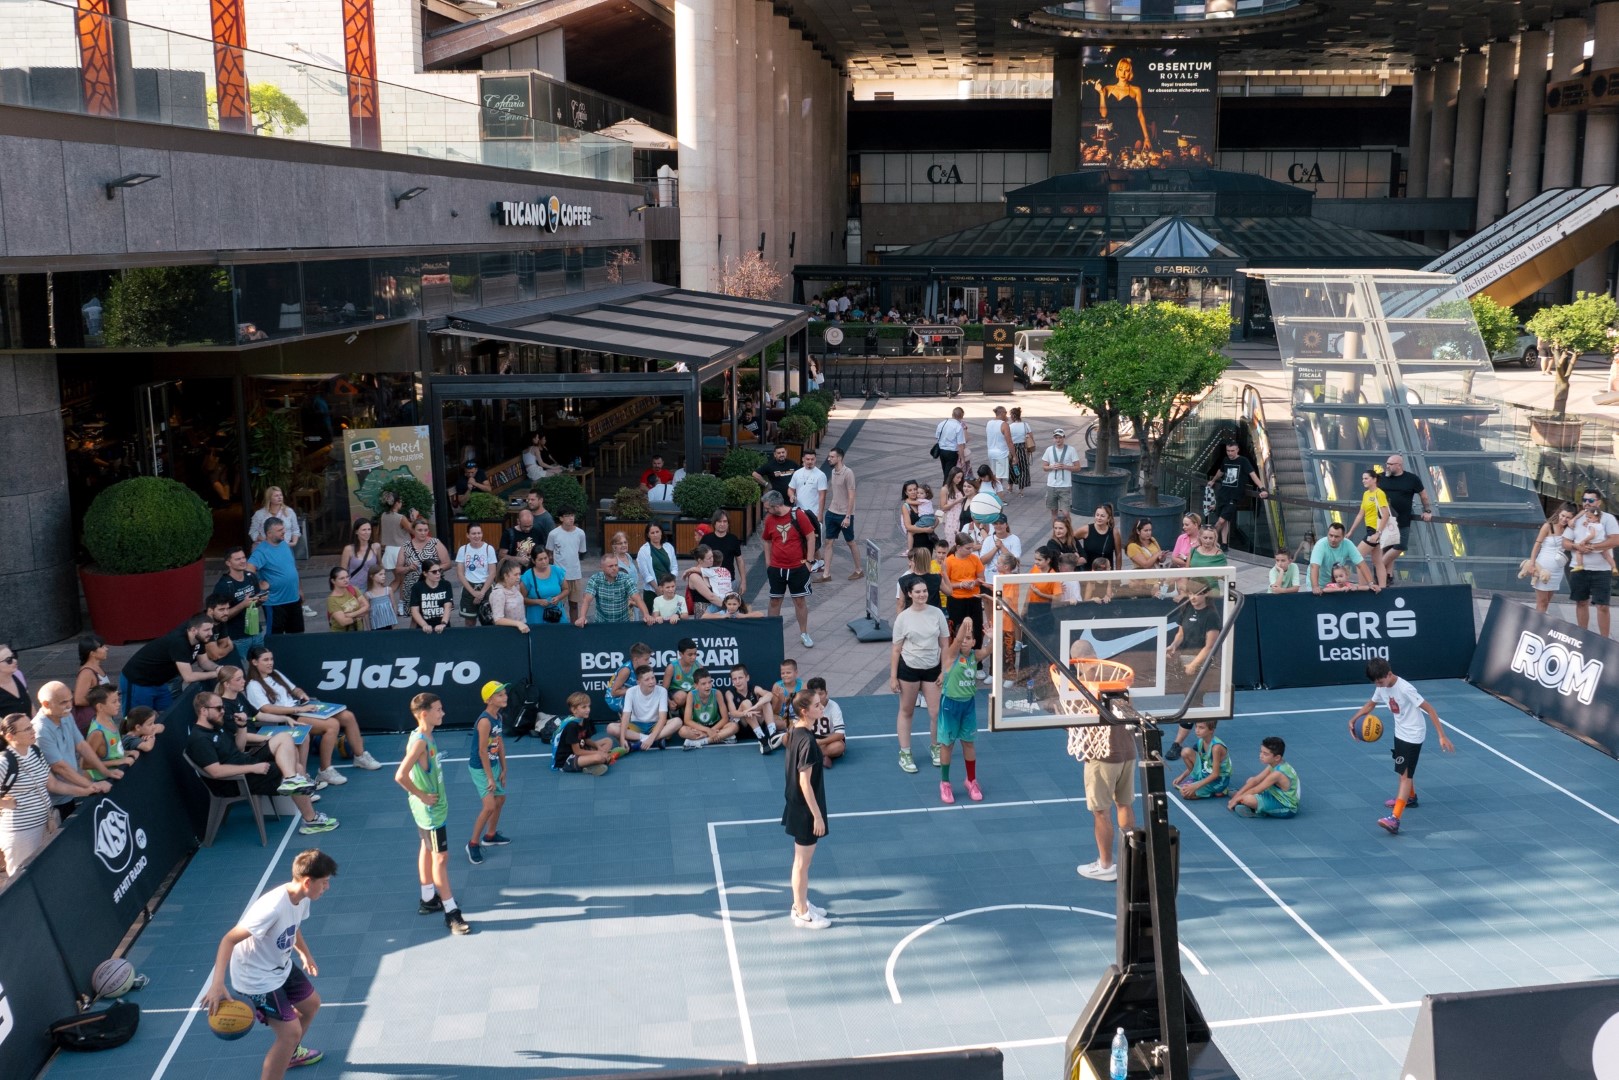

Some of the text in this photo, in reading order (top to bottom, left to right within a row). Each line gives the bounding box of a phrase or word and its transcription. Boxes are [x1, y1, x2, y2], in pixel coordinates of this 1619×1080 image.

[1148, 62, 1212, 71] OBSENTUM
[1160, 72, 1199, 80] ROYALS
[927, 164, 964, 185] C&A
[1287, 162, 1325, 183] C&A
[502, 201, 592, 226] TUCANO COFFEE
[1455, 267, 1498, 299] Policlinica
[1497, 249, 1528, 276] Regina
[1527, 234, 1553, 253] Maria
[421, 591, 447, 601] BASKET
[421, 600, 440, 609] BALL
[1316, 611, 1382, 640] BCR
[701, 636, 739, 648] VIATA
[1547, 629, 1583, 649] AUTENTIC
[580, 652, 624, 670] BCR
[1319, 643, 1390, 661] Leasing
[1510, 630, 1604, 706] ROM
[120, 875, 132, 895] HIT
[129, 855, 148, 882] RADIO
